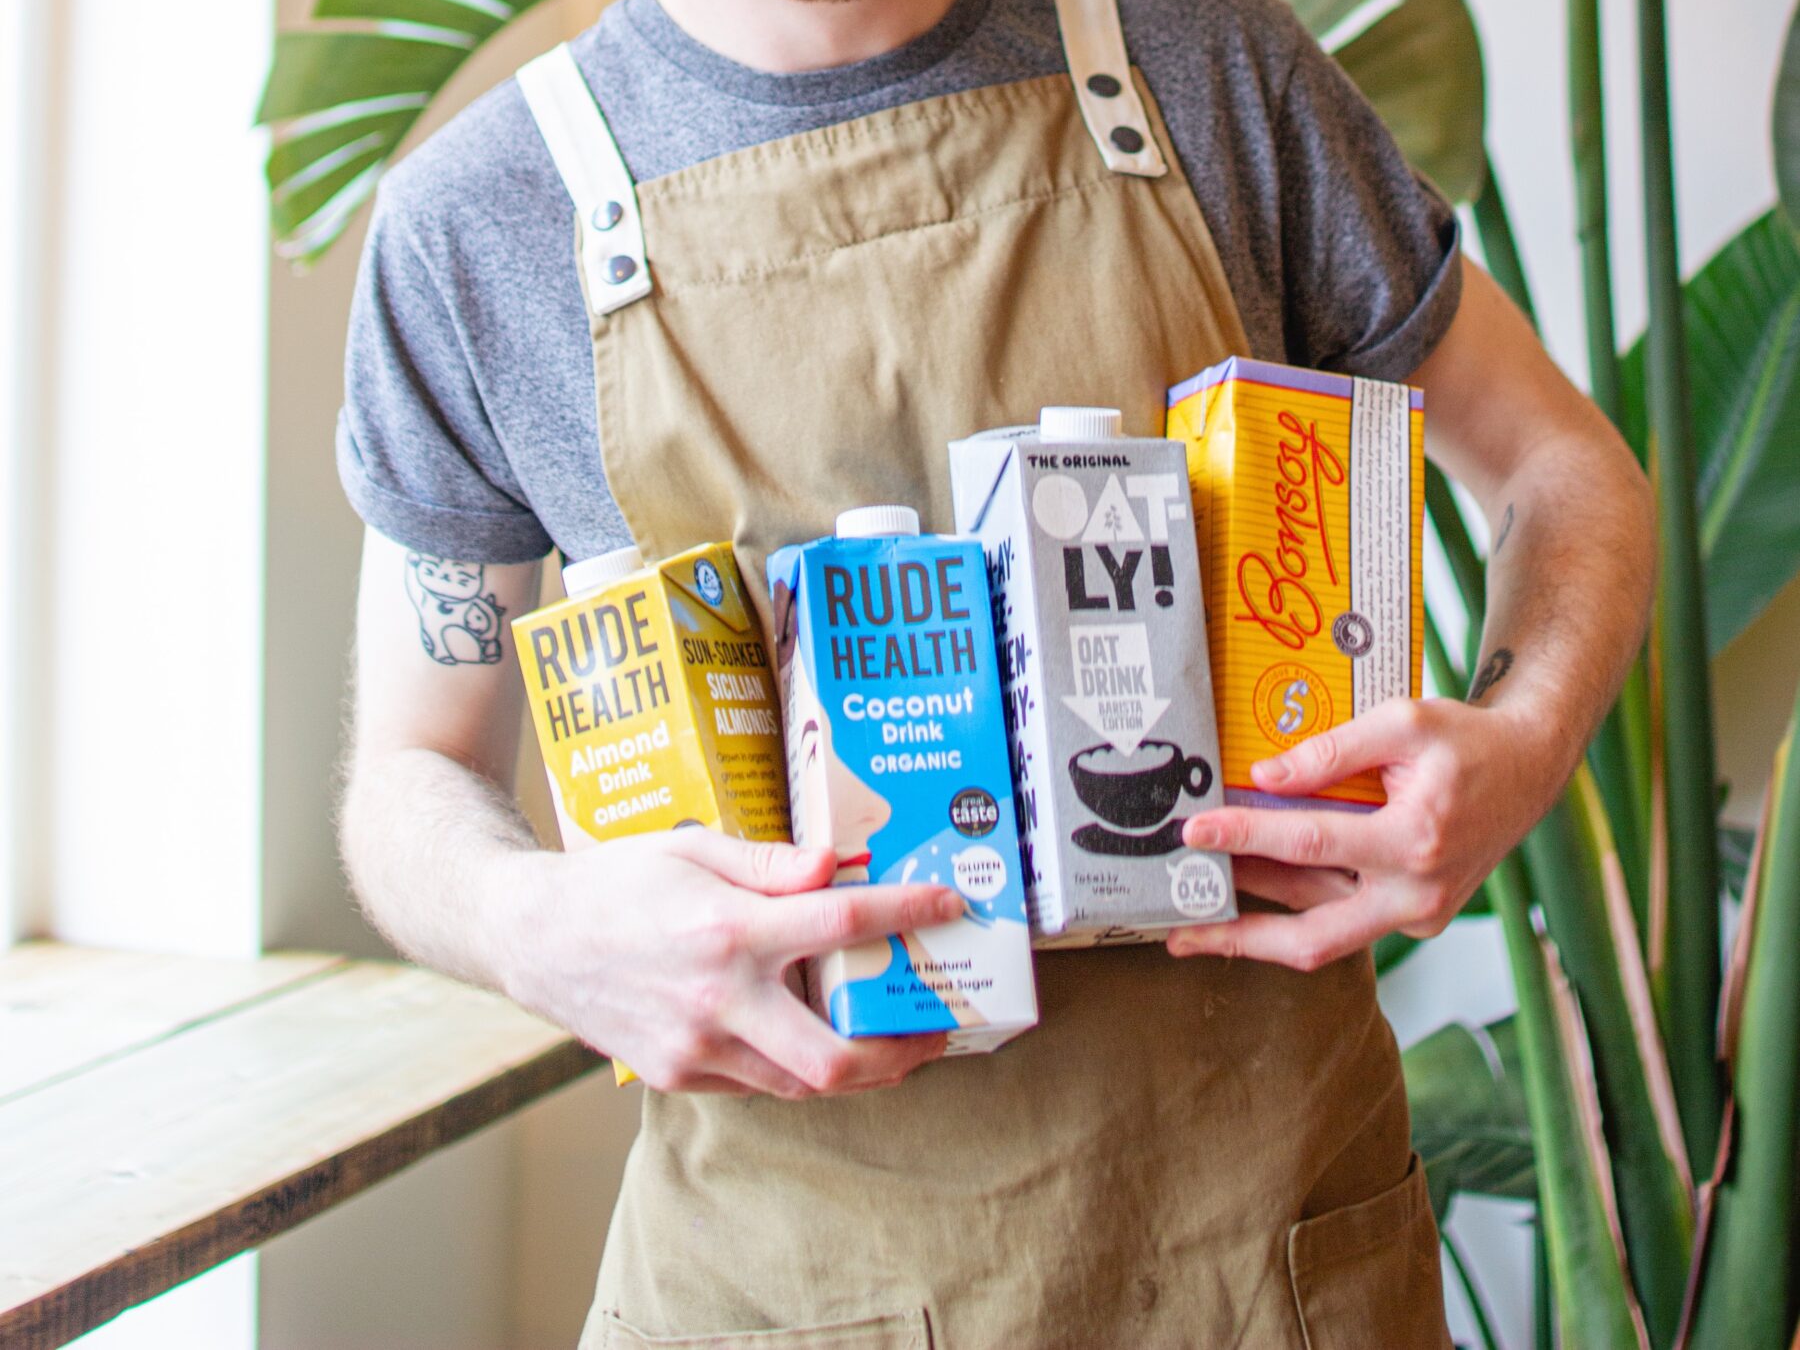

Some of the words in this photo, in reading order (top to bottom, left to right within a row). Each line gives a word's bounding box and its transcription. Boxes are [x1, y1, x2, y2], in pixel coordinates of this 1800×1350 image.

[1027, 454, 1058, 469] THE
[1062, 454, 1132, 468] ORIGINAL
[1233, 410, 1346, 651] Bonsoy
[823, 555, 971, 628] RUDE
[1062, 544, 1175, 612] LY!
[530, 590, 659, 691] RUDE
[682, 637, 767, 668] SUN-SOAKED
[830, 627, 978, 681] HEALTH
[1077, 634, 1120, 665] OAT
[706, 671, 767, 701] SICILIAN
[1081, 664, 1148, 698] DRINK
[545, 660, 671, 743] HEALTH
[842, 685, 974, 721] Coconut
[713, 707, 779, 736] ALMONDS
[882, 721, 944, 745] Drink
[570, 719, 671, 778] Almond
[870, 749, 962, 775] ORGANIC
[598, 760, 653, 795] Drink
[594, 786, 673, 826] ORGANIC
[952, 805, 998, 825] taste
[958, 860, 1001, 874] GLUTEN
[968, 875, 993, 887] FREE
[1074, 872, 1119, 884] Totally
[904, 961, 921, 975] All
[924, 957, 972, 972] Natural
[886, 983, 905, 996] No
[909, 979, 953, 994] Added
[957, 978, 993, 992] Sugar
